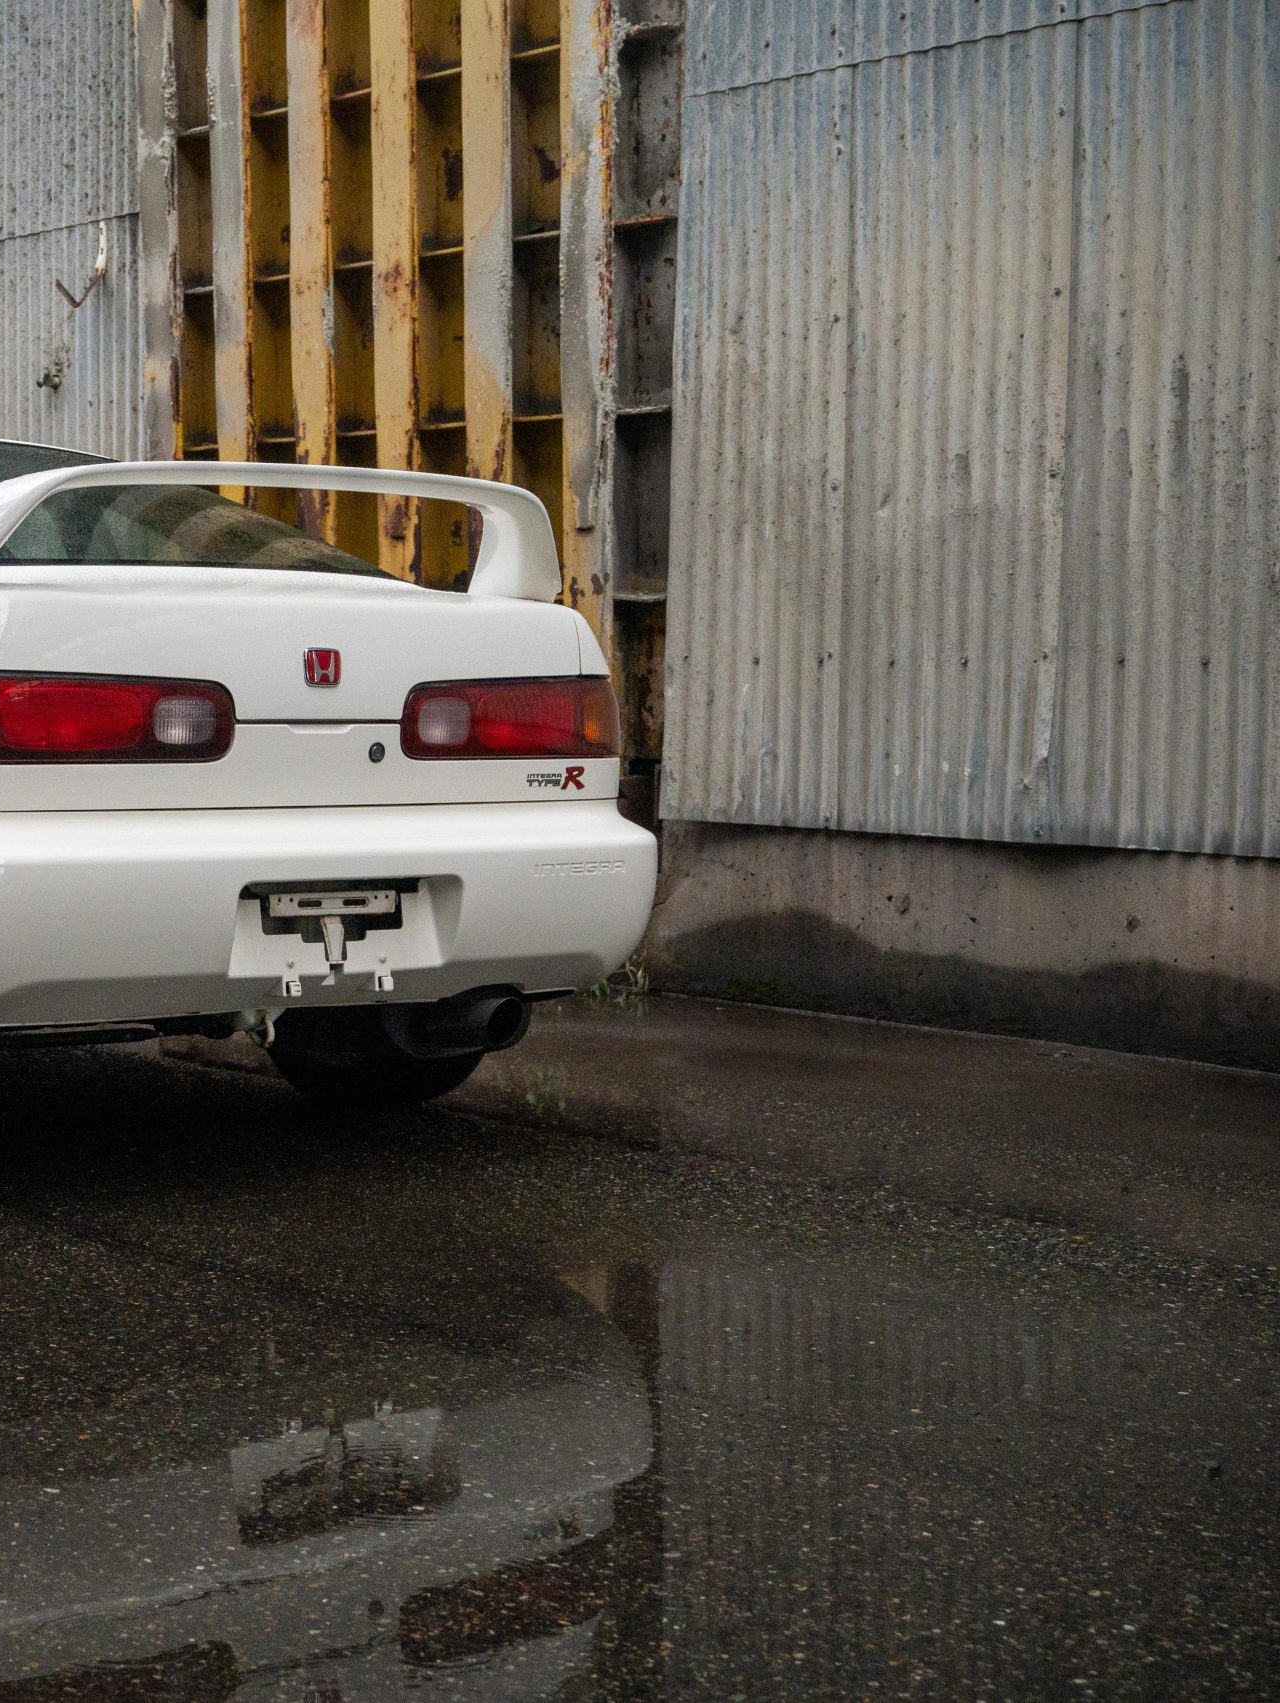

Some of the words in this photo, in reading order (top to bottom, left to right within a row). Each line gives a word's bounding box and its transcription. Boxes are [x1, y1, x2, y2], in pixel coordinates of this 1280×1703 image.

[526, 779, 561, 787] TYPE
[561, 766, 585, 790] R
[534, 860, 625, 877] INTEGRA
